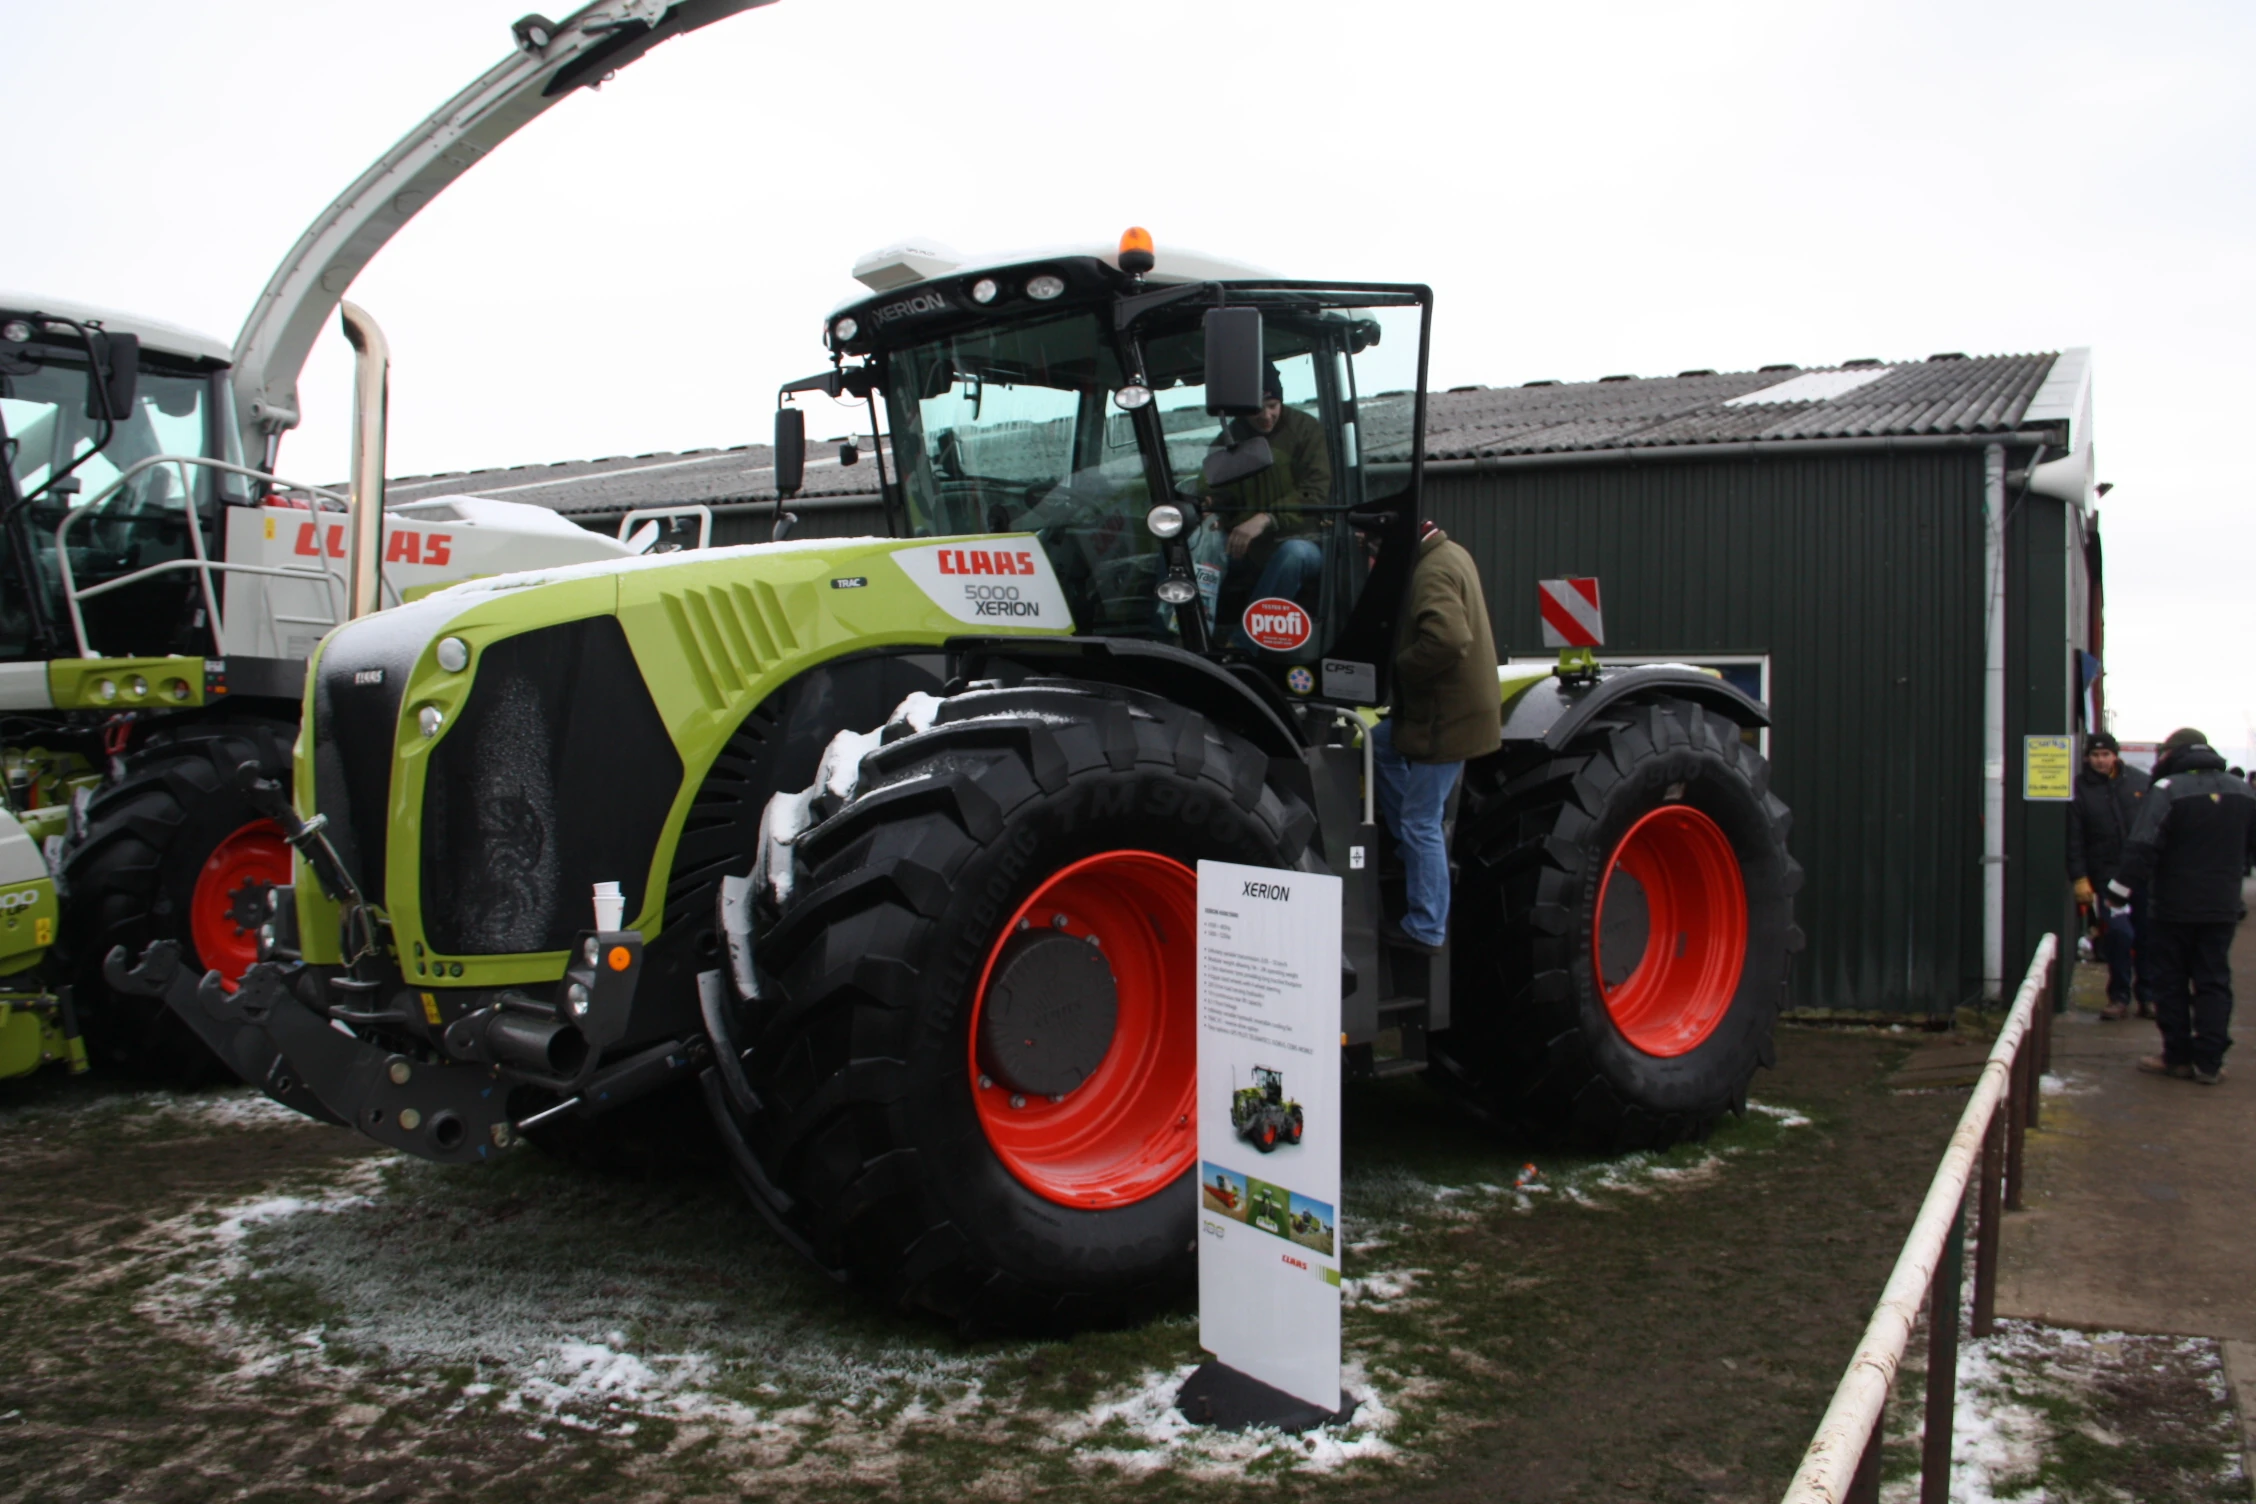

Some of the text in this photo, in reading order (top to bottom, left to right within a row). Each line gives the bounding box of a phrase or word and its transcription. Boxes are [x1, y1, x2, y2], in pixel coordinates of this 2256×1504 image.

[872, 292, 946, 325] XERION
[294, 522, 452, 566] CLAS
[937, 550, 1035, 576] CLAAS
[837, 578, 861, 588] TRAC
[964, 585, 1020, 601] 5000
[975, 601, 1040, 617] XERION
[1251, 611, 1302, 635] profi
[1325, 662, 1355, 675] CPS
[1242, 881, 1290, 902] XERION
[1282, 1254, 1308, 1270] CLAAS
